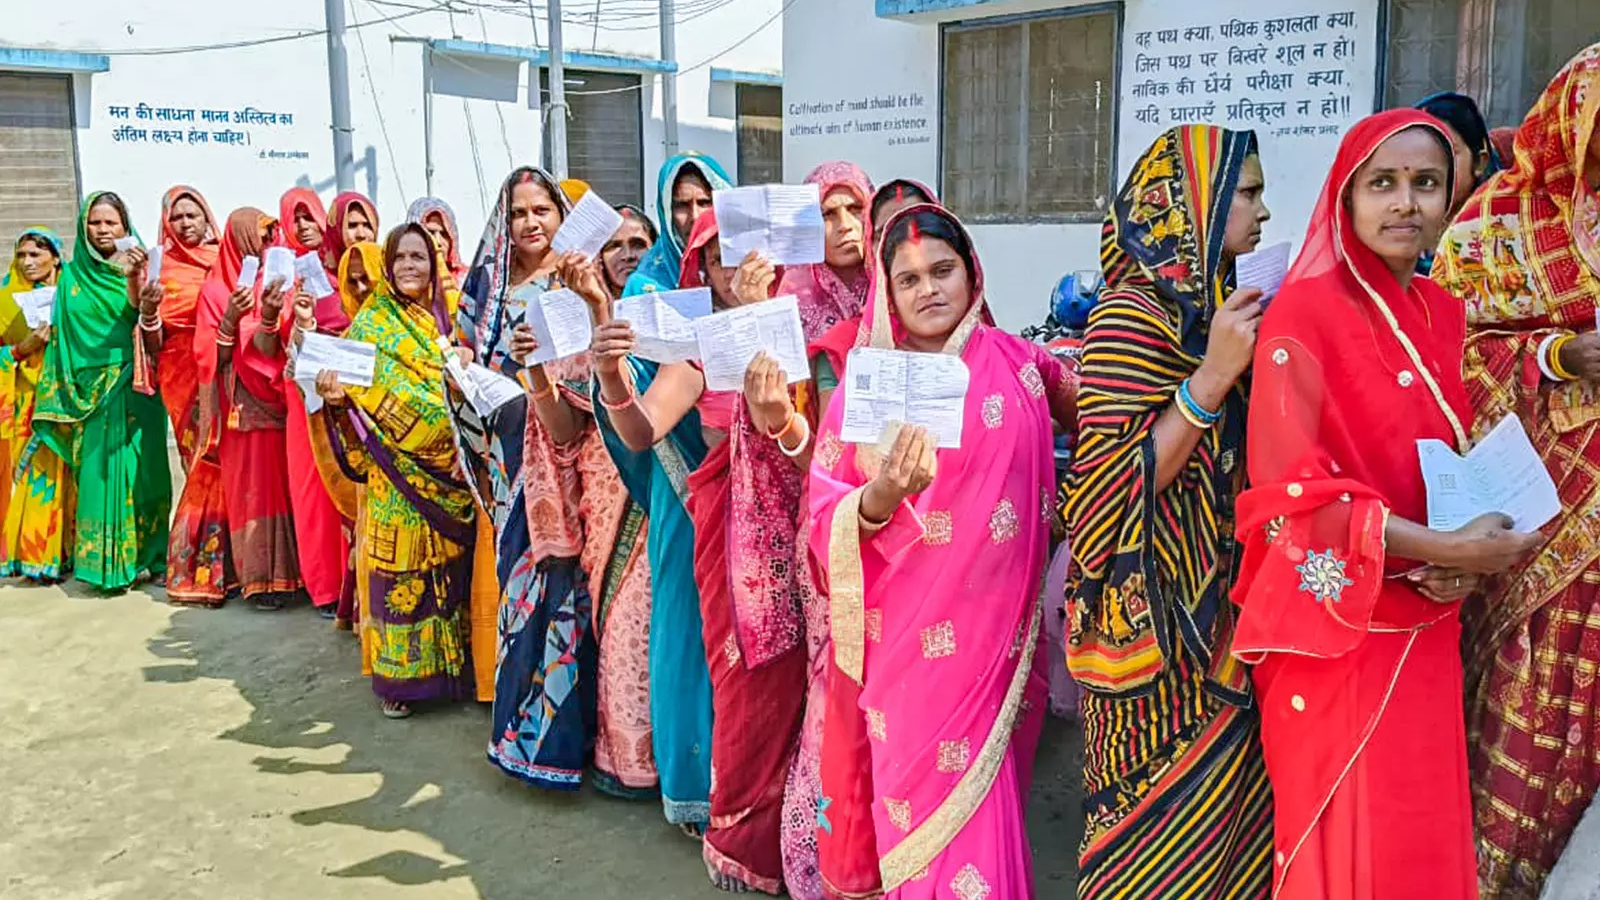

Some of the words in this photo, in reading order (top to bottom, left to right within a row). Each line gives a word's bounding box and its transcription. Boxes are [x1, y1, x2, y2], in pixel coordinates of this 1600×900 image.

[1135, 32, 1152, 50] वह
[1156, 29, 1178, 44] पथ
[1220, 19, 1260, 38] पथिक
[1263, 15, 1320, 41] कुशलता
[1135, 53, 1160, 73] जिस
[1168, 54, 1191, 70] पथ
[1199, 53, 1218, 67] पर
[1228, 43, 1268, 66] बिखरे
[1276, 44, 1306, 66] शूल
[1313, 43, 1327, 58] न
[1132, 79, 1169, 98] नाविक
[1176, 77, 1195, 95] की
[1204, 72, 1232, 93] धैर्य
[1246, 69, 1294, 91] परीक्षा
[108, 106, 130, 119] मन
[135, 102, 153, 120] की
[156, 108, 195, 122] साधना
[200, 110, 229, 122] मानव
[233, 107, 277, 125] अस्तित्व
[277, 113, 293, 125] का
[835, 100, 845, 112] of
[1135, 104, 1160, 125] यदि
[1226, 98, 1286, 125] प्रतिकूल
[1297, 100, 1311, 115] न
[112, 125, 147, 141] अंतिम
[152, 130, 183, 144] लक्ष्य
[188, 127, 208, 145] होना
